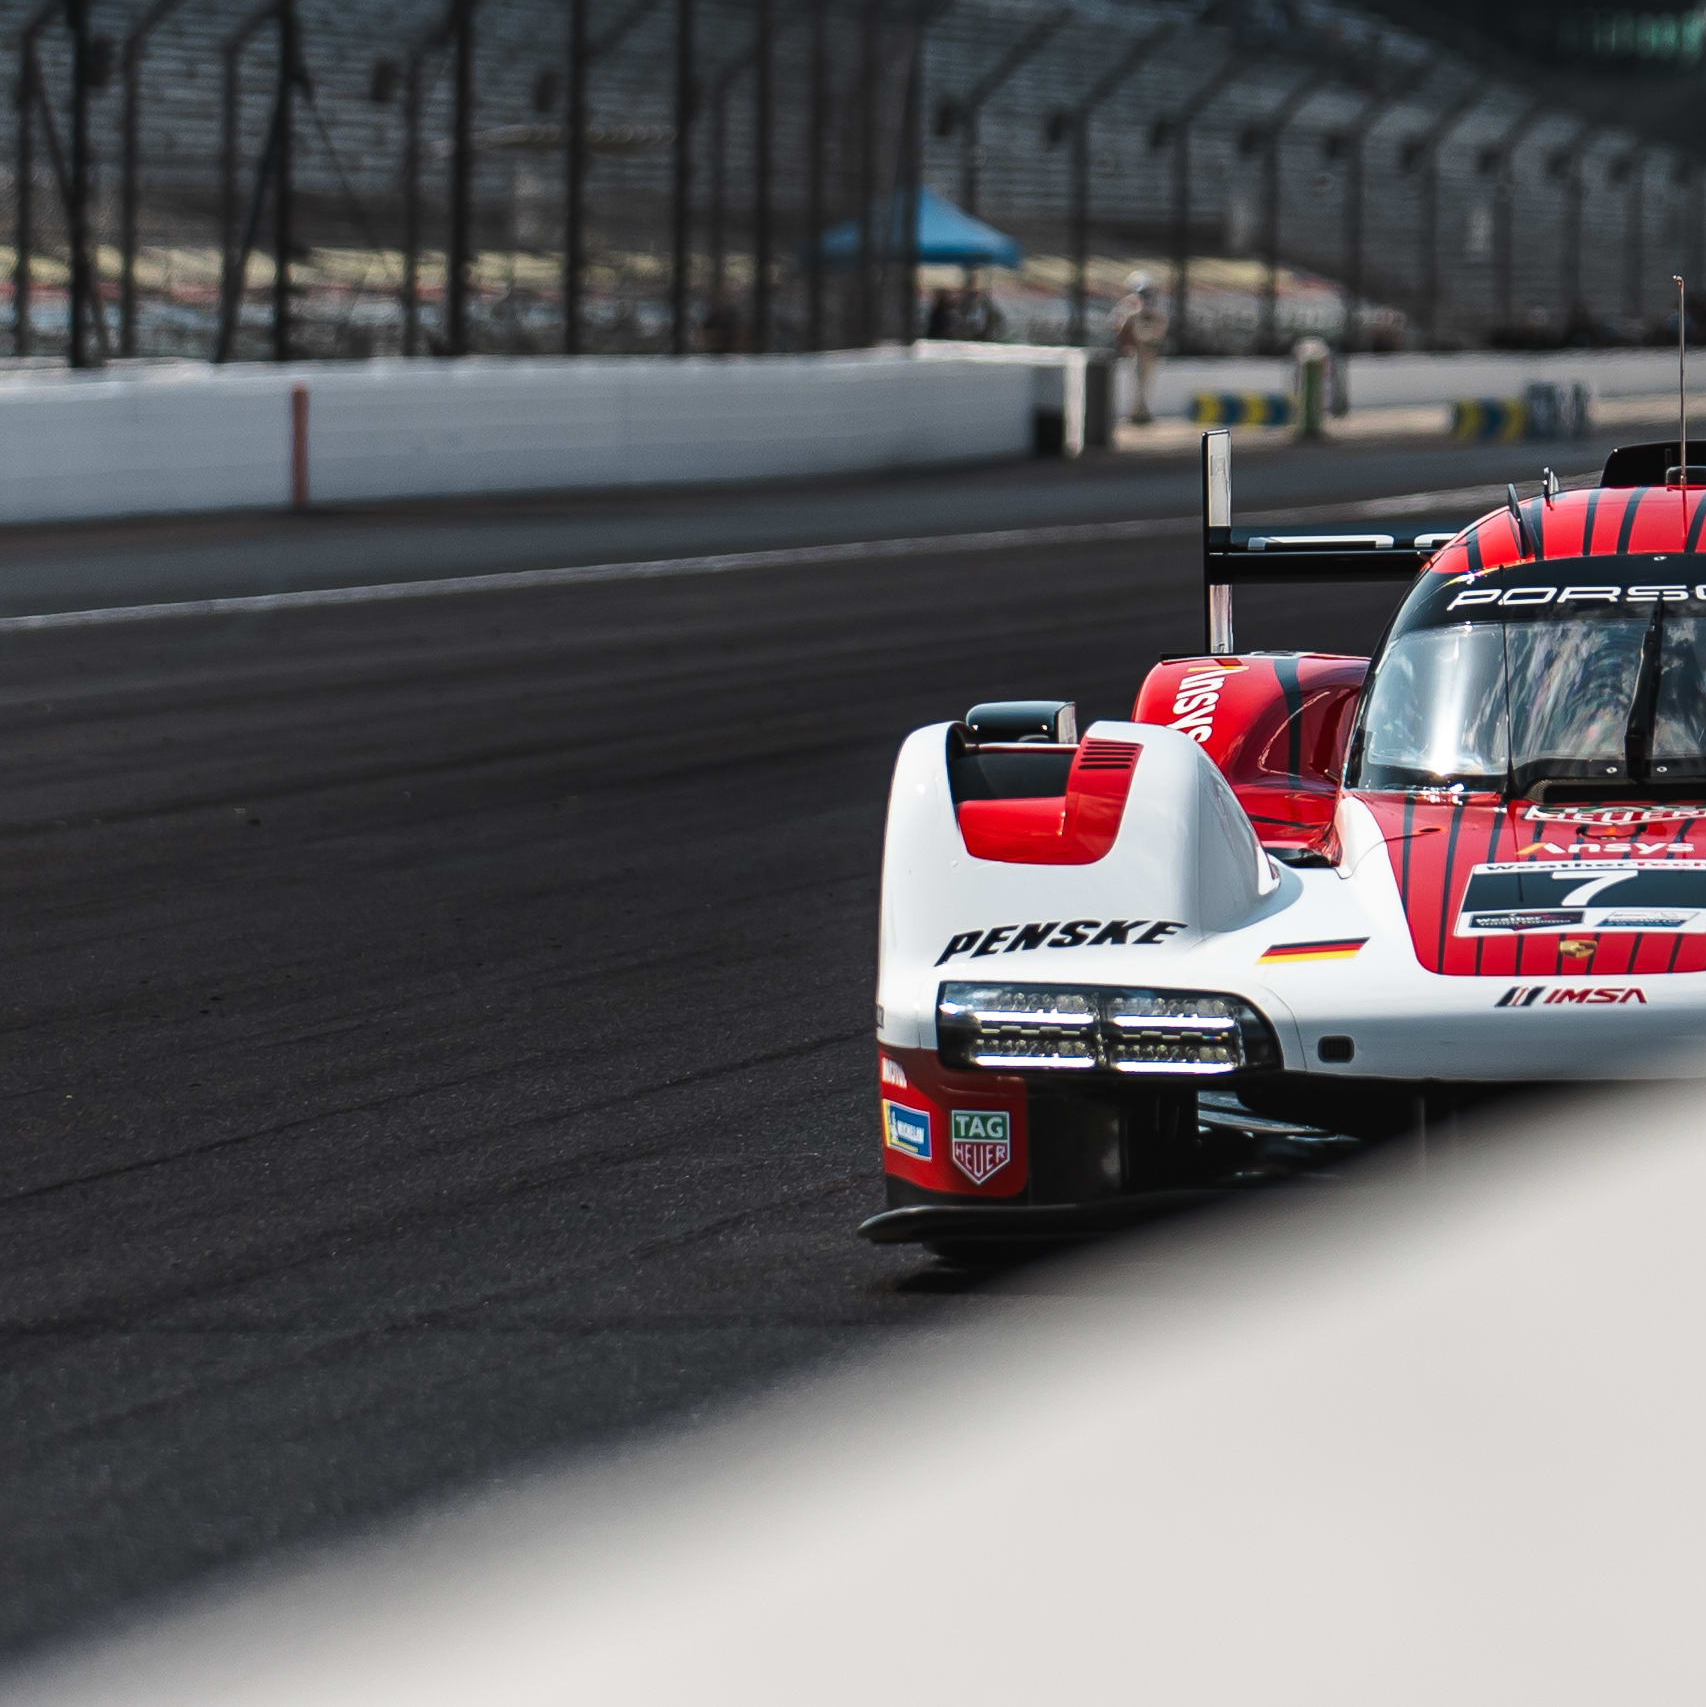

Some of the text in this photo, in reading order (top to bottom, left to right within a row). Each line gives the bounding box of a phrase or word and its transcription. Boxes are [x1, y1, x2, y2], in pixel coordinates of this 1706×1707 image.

[1517, 842, 1695, 855] Ansys
[1551, 869, 1639, 907] 7
[932, 919, 1189, 968] PENSKE
[1543, 988, 1647, 1004] IMSA
[955, 1115, 1003, 1138] TAG
[955, 1144, 1006, 1177] HEUER
